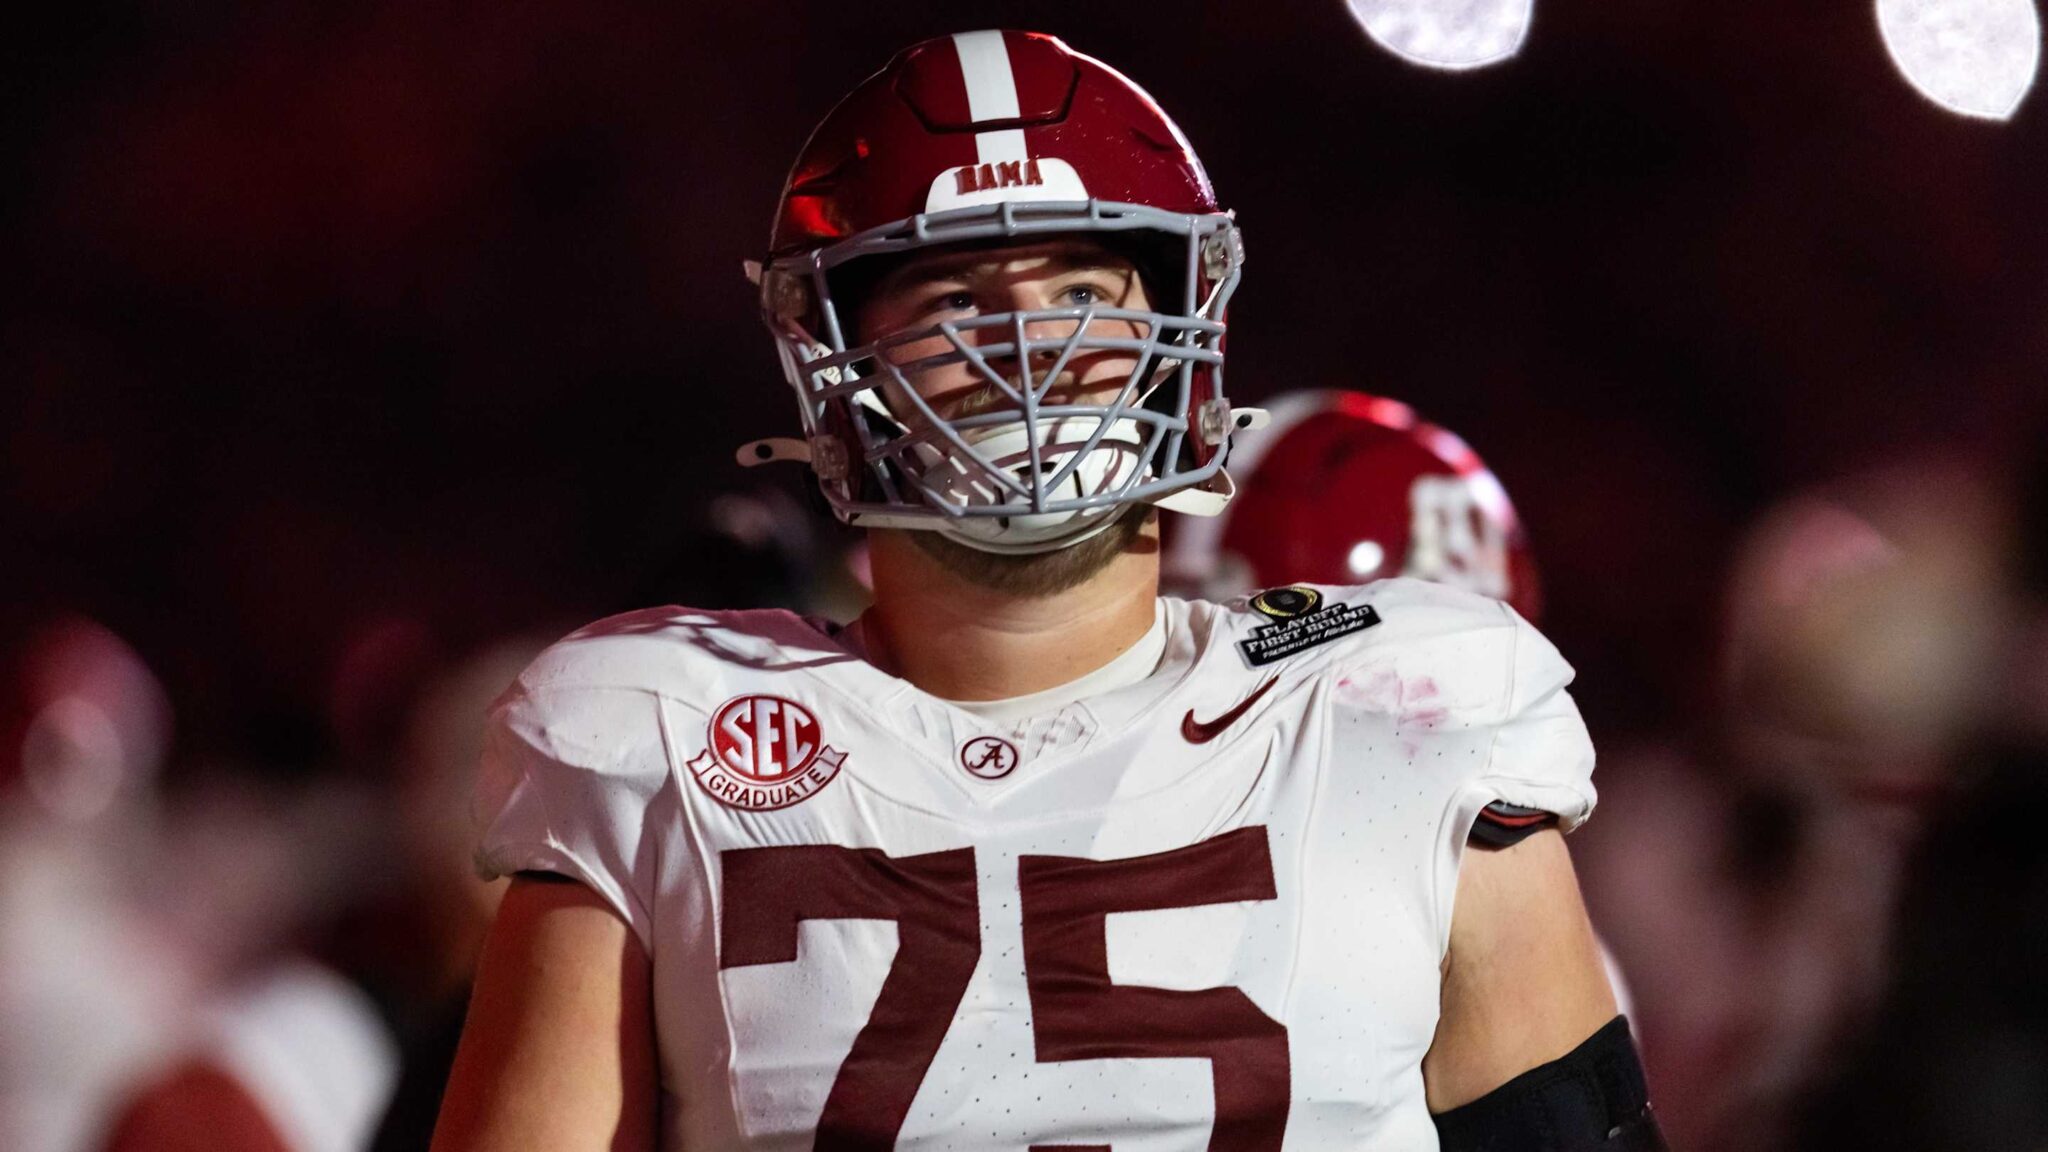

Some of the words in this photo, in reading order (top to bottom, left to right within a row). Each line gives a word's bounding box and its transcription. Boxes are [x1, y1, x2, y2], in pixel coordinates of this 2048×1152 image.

[954, 159, 1043, 195] BAMA
[1246, 628, 1301, 653] FIRST
[1305, 605, 1370, 634] ROUND
[1261, 604, 1343, 638] PLAYOFF
[721, 699, 813, 776] SEC
[969, 742, 1005, 770] A
[708, 767, 827, 808] GRADUATE
[719, 824, 1292, 1152] 75
